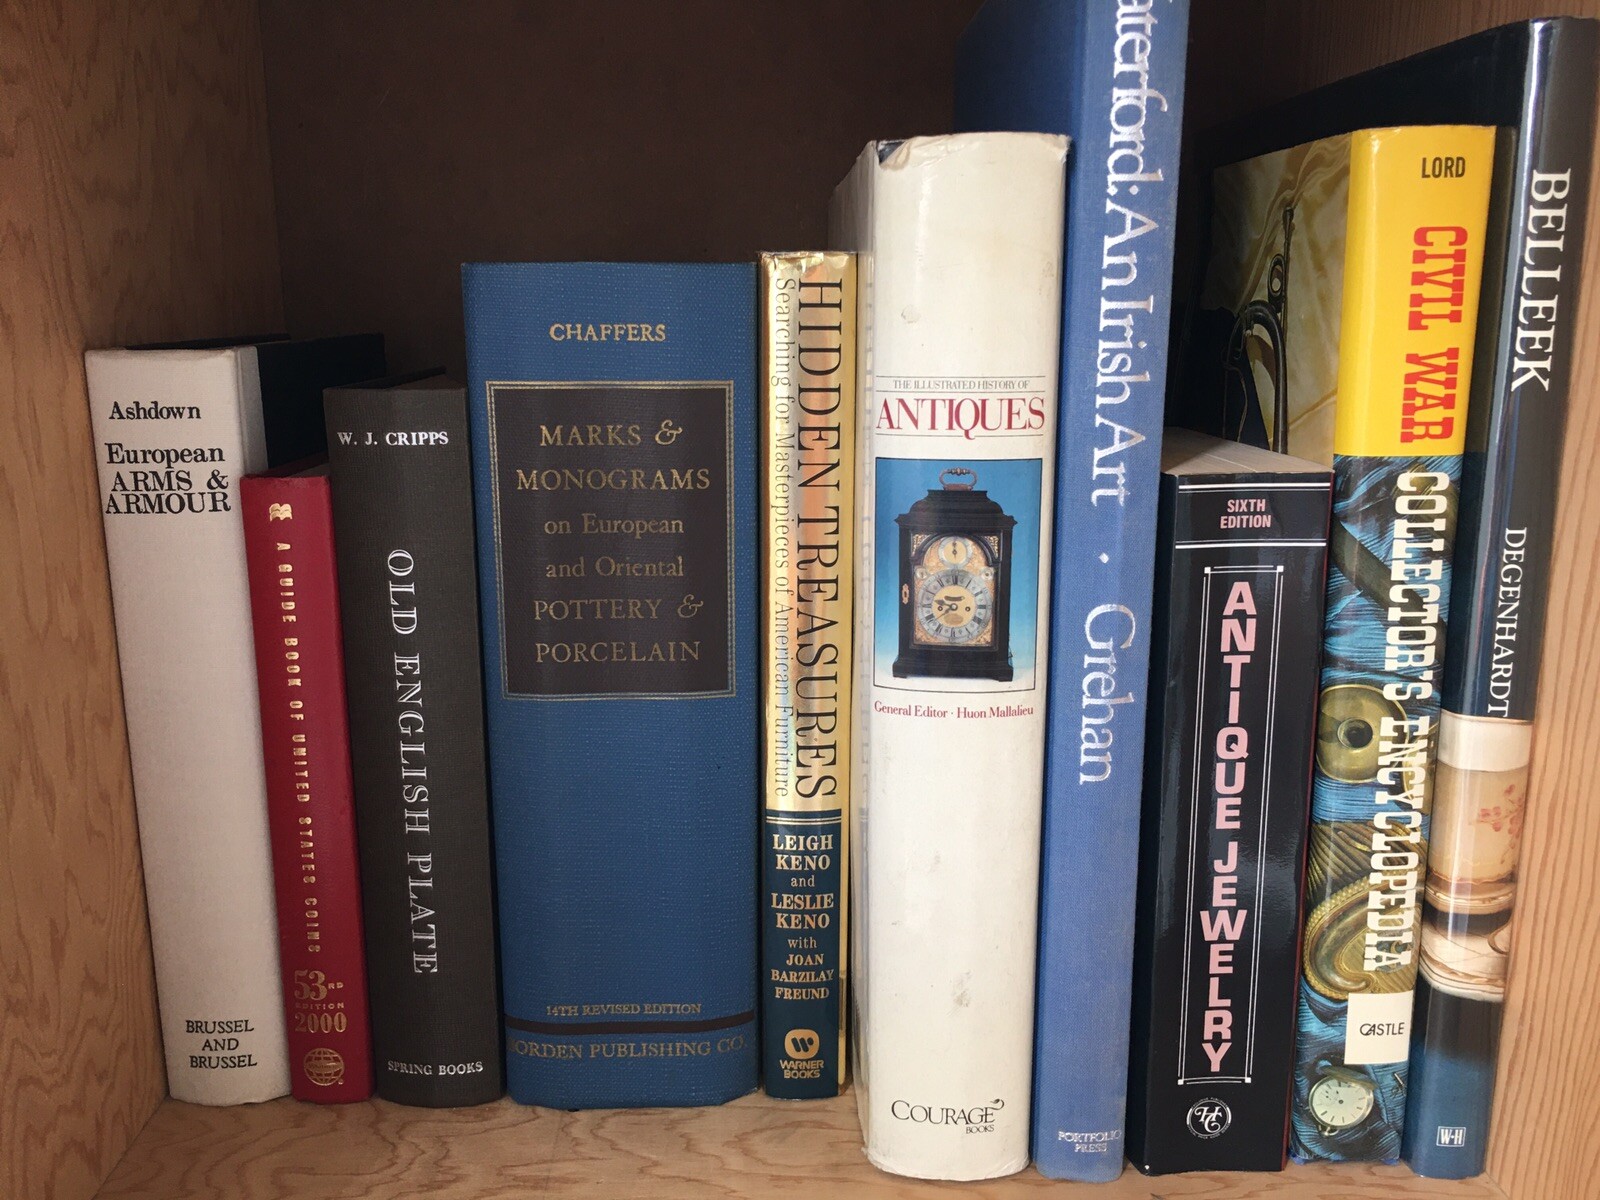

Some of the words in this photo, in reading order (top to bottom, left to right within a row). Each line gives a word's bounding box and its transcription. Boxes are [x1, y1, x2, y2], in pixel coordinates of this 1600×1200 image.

[1106, 0, 1168, 196] aterford:
[1421, 156, 1466, 179] LORD
[1101, 198, 1159, 291] An
[1408, 226, 1469, 331] CIVIL
[1511, 167, 1571, 392] BELLEEK
[549, 323, 666, 342] CHAFFERS
[771, 278, 796, 387] Searching
[1095, 295, 1154, 408] Irish
[797, 278, 843, 491] HIDDEN
[893, 379, 912, 389] THE
[913, 379, 976, 390] ILLUSTRATED
[977, 379, 1015, 390] HISTORY
[1017, 379, 1030, 389] OF
[1400, 347, 1460, 443] WAR
[108, 401, 201, 420] Ashdown
[775, 396, 796, 426] for
[875, 396, 1045, 440] ANTIQUES
[337, 431, 358, 446] W.
[365, 431, 378, 446] J.
[385, 431, 450, 446] CRIPPS
[539, 425, 642, 447] MARKS
[654, 419, 683, 446] &
[104, 443, 226, 469] European
[1090, 414, 1146, 507] Art
[111, 470, 193, 492] ARMS
[206, 469, 229, 491] &
[516, 468, 711, 491] MONOGRAMS
[104, 491, 232, 515] ARMOUR
[770, 432, 795, 568] Masterpieces
[1226, 499, 1266, 513] SIXTH
[544, 520, 572, 535] on
[581, 513, 684, 540] European
[1220, 514, 1272, 529] EDITION
[276, 542, 291, 551] A
[545, 557, 585, 578] and
[595, 556, 684, 578] Oriental
[278, 564, 297, 623] GUIDE
[387, 549, 420, 635] OLD
[775, 576, 794, 595] of
[1382, 471, 1450, 702] COLLECTOR'S
[533, 598, 662, 621] POTTERY
[676, 594, 704, 619] &
[1487, 527, 1527, 718] DEGENHARDT
[535, 641, 701, 664] PORCELAIN
[774, 601, 794, 696] American
[795, 505, 840, 799] TREASURES
[284, 637, 302, 687] BOOK
[1079, 603, 1136, 786] Grehan
[1214, 581, 1258, 830] ANTIQUE
[290, 700, 304, 721] OF
[874, 700, 912, 717] General
[914, 704, 949, 719] Editor
[956, 706, 987, 719] Huon
[988, 704, 1034, 719] Mallalieu
[393, 652, 431, 835] ENGLISH
[774, 705, 794, 798] Furniture
[291, 734, 311, 803] UNITED
[298, 816, 316, 884] STATES
[772, 834, 834, 851] LEIGH
[1363, 716, 1430, 971] ENCYCLOPEDIA
[775, 854, 831, 871] KENO
[790, 875, 815, 887] and
[771, 892, 834, 910] LESLIE
[304, 897, 321, 952] COINS
[407, 852, 438, 974] PLATE
[775, 912, 831, 929] KENO
[787, 936, 817, 949] with
[786, 953, 824, 966] JOAN
[1200, 841, 1247, 1073] JEWELRY
[770, 969, 834, 983] BARZILAY
[774, 987, 830, 1000] FREUND
[546, 1005, 579, 1017] 14TH
[581, 1004, 641, 1016] REVISED
[643, 1003, 702, 1015] EDITION
[185, 1019, 255, 1035] BRUSSEL
[295, 1012, 348, 1034] 2000
[1359, 1021, 1405, 1037] CASTLE
[201, 1038, 240, 1052] AND
[506, 1036, 583, 1059] ORDEN
[589, 1040, 711, 1059] PUBLISHING
[189, 1054, 258, 1069] BRUSSEL
[387, 1060, 433, 1076] SPRING
[438, 1061, 484, 1076] BOOKS
[779, 1059, 825, 1071] WARNER
[783, 1068, 821, 1079] BOOKS
[891, 1098, 1005, 1126] COURAGE
[966, 1124, 995, 1135] BOOKS
[1058, 1129, 1122, 1143] PORTFOLIO
[1074, 1142, 1107, 1153] PRESS
